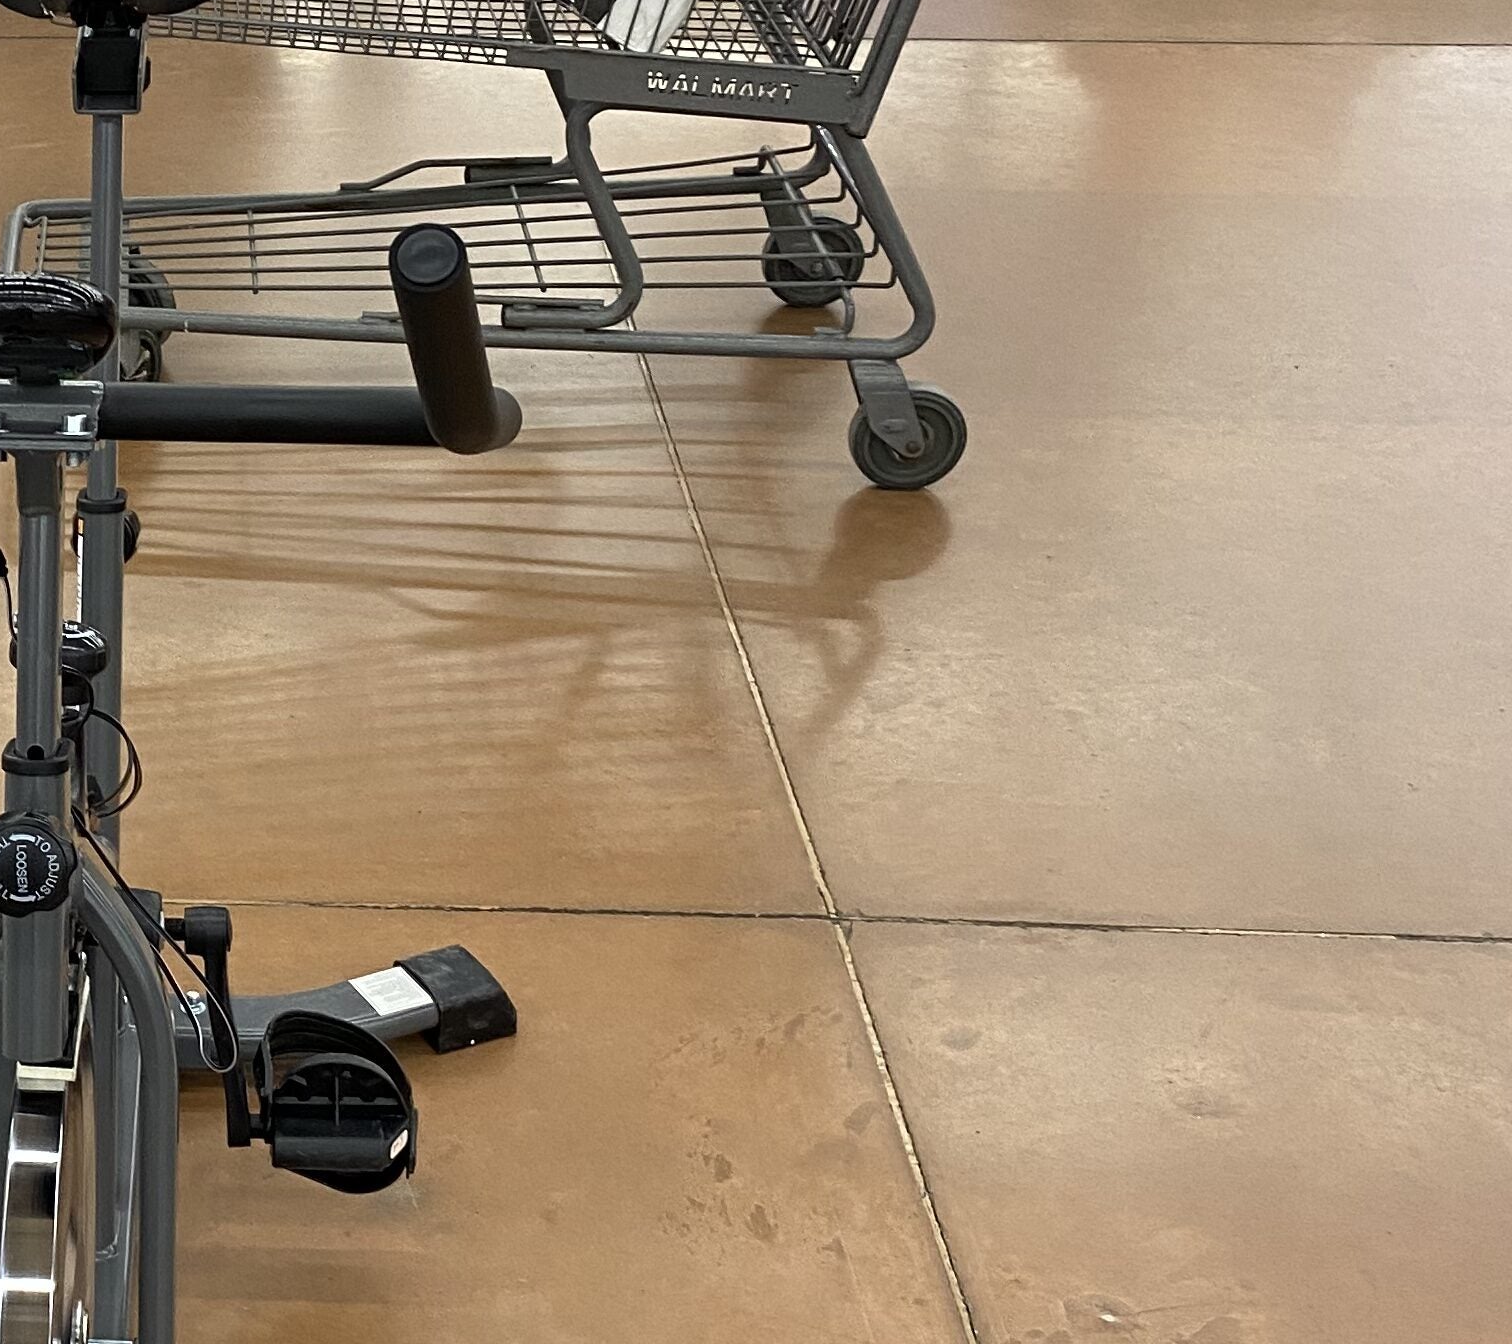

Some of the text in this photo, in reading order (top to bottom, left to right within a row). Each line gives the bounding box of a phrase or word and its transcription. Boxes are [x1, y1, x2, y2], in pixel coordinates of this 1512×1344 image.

[647, 71, 799, 104] WALMART
[16, 845, 28, 892] LOOSEN
[34, 835, 60, 901] TO ADJUST
